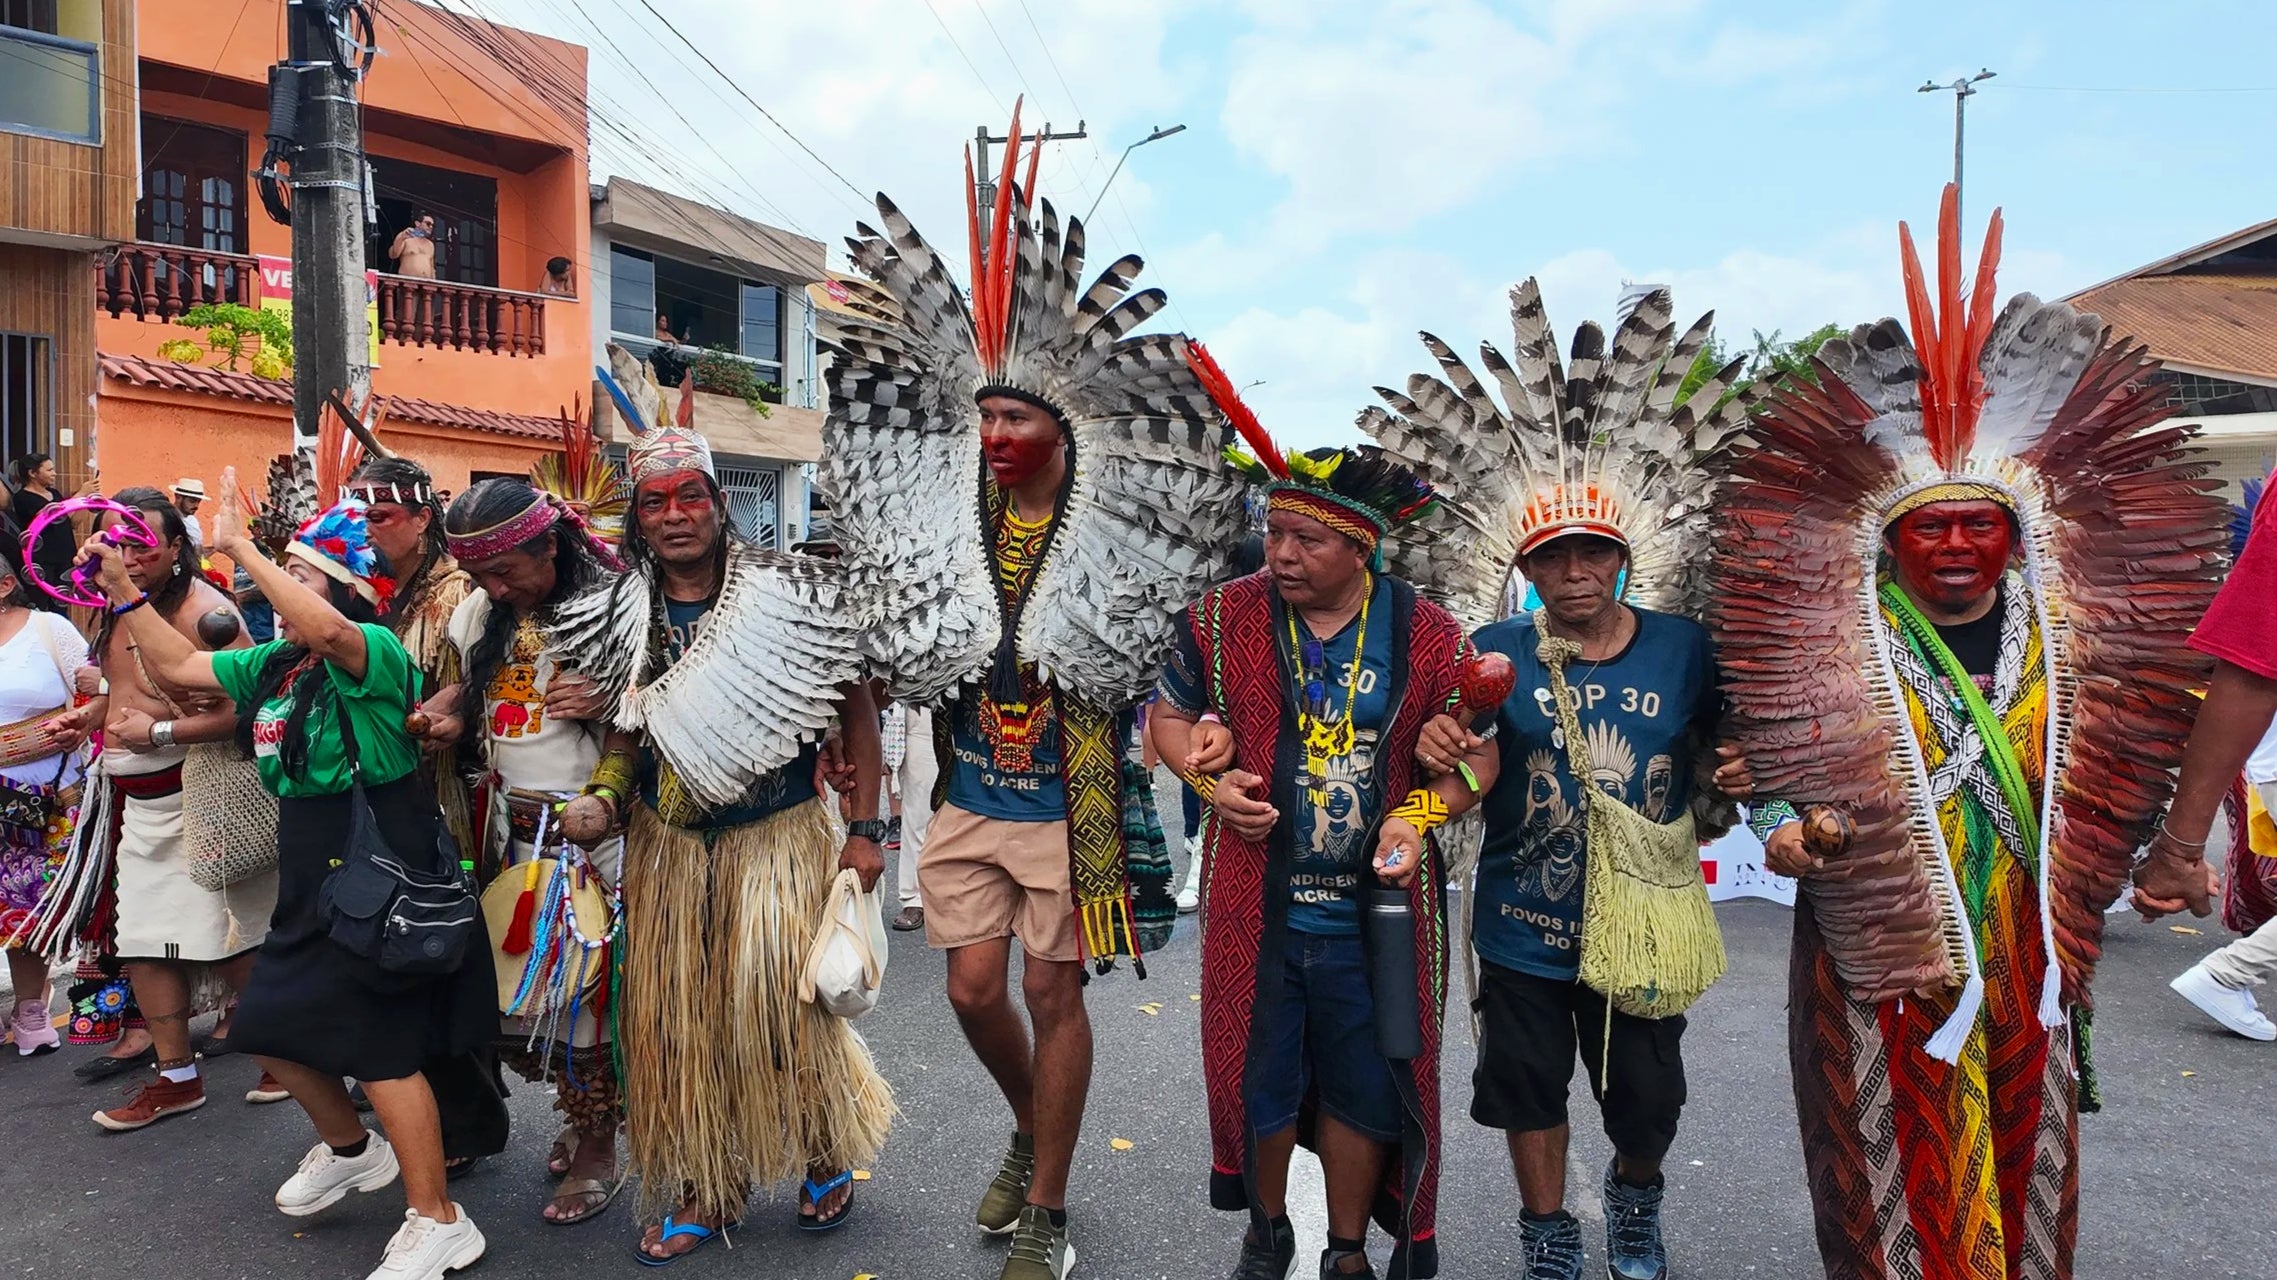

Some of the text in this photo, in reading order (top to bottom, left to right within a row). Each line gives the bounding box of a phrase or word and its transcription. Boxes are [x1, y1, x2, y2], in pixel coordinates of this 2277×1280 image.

[262, 268, 292, 288] VE
[1337, 662, 1377, 694] 30
[1620, 687, 1660, 717] 30
[955, 748, 988, 769] POVS
[1293, 889, 1341, 903] ACRE
[1501, 903, 1563, 931] POVOS
[1544, 932, 1571, 950] DO
